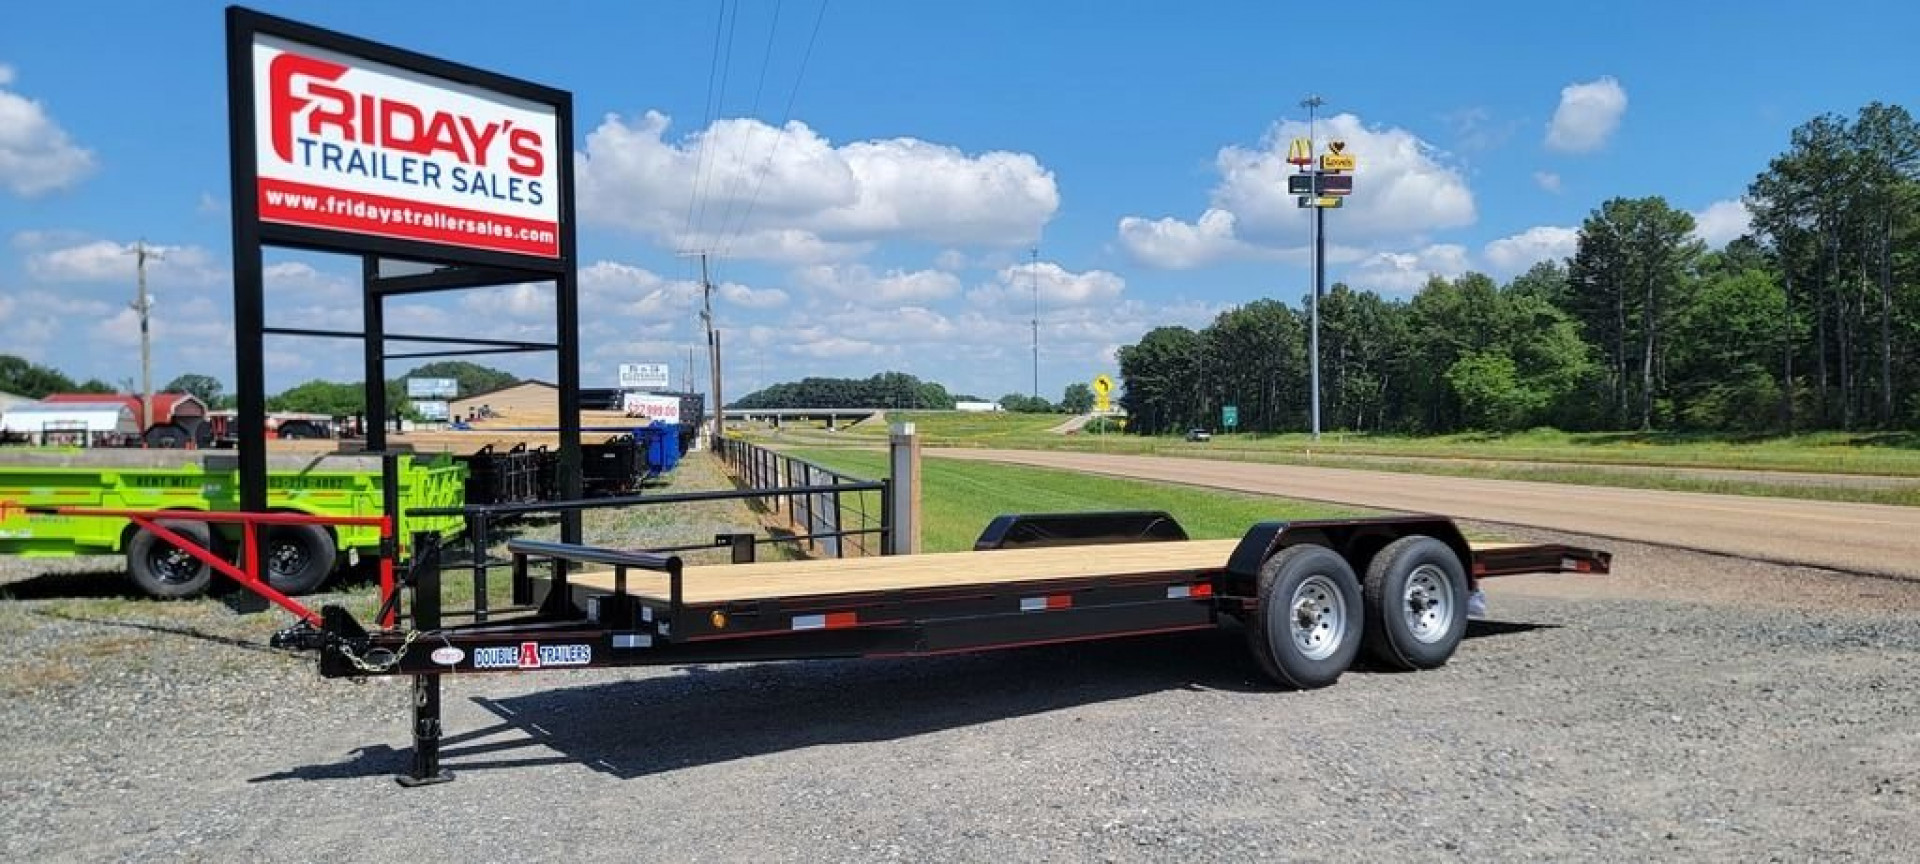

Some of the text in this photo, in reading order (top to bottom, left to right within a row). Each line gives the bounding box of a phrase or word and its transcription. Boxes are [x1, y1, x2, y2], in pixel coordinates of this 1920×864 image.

[269, 52, 544, 177] FRIDAY'S
[297, 138, 543, 205] TRAILER SALES
[266, 190, 554, 244] www.fridaystrailersales.com
[474, 648, 518, 667] DOUBLE
[519, 642, 540, 667] A
[540, 645, 591, 666] TRAILERS
